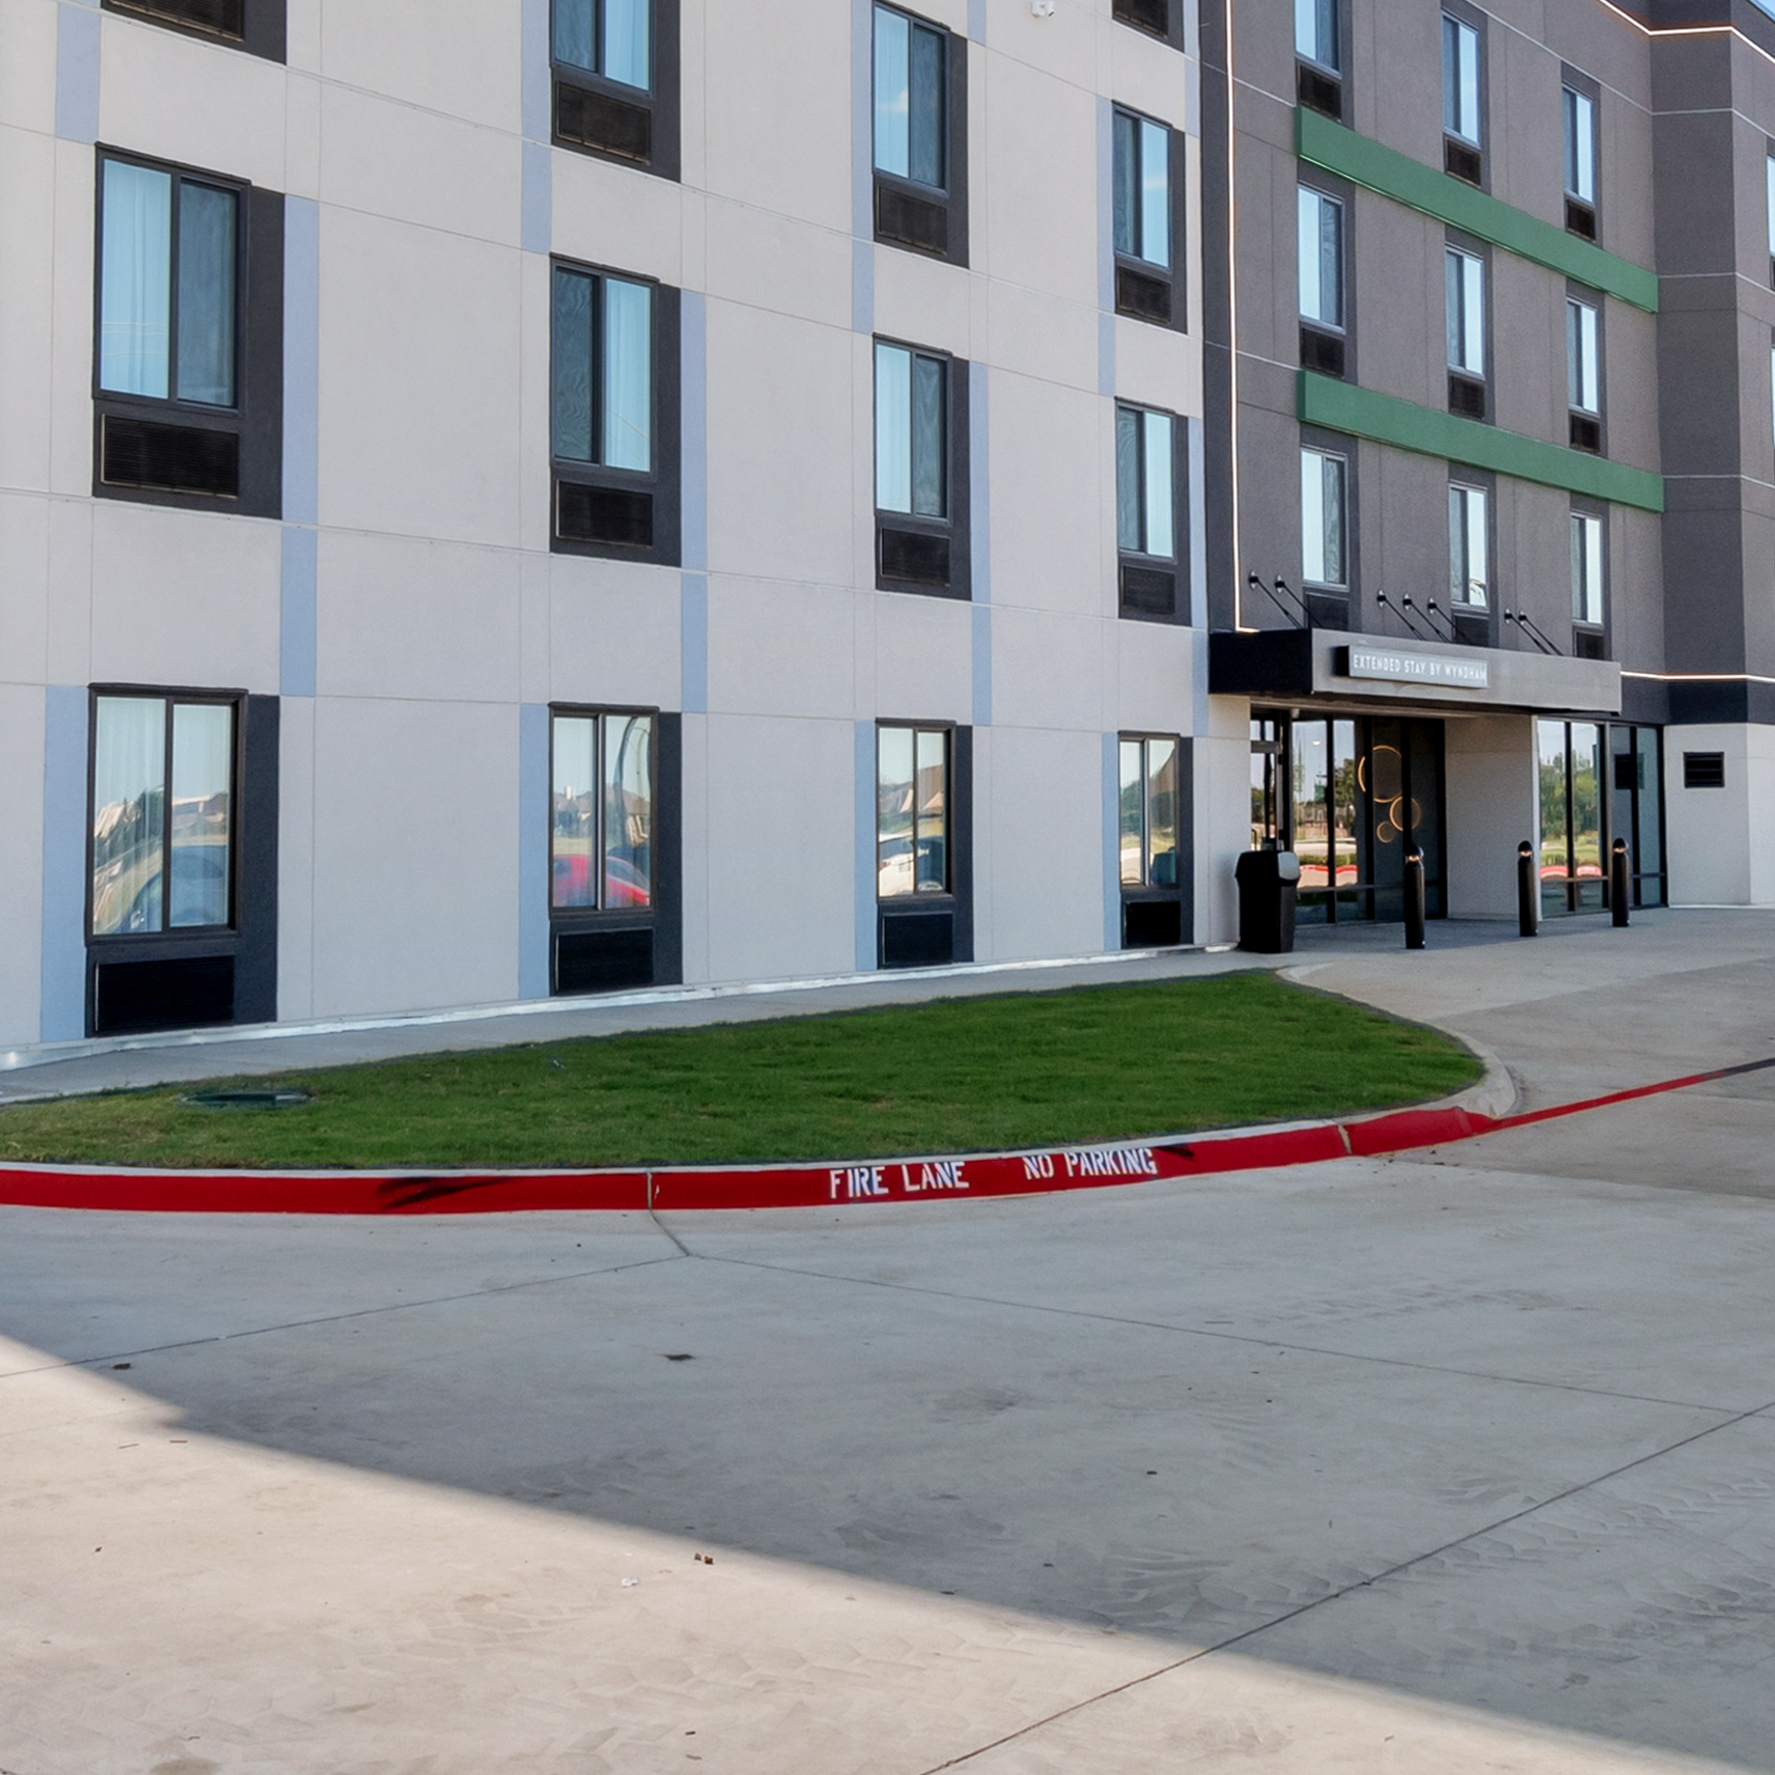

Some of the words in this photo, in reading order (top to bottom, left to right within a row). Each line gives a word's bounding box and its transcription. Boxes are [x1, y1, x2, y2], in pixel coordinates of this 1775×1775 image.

[1352, 654, 1402, 673] EXTENDED
[1404, 659, 1426, 675] STAY
[1429, 662, 1442, 676] BY
[1443, 664, 1487, 681] WYNDHAM
[829, 1166, 889, 1199] FIRE
[902, 1161, 969, 1193] LANE
[1022, 1154, 1054, 1180] NO
[1063, 1148, 1157, 1177] PARKING
